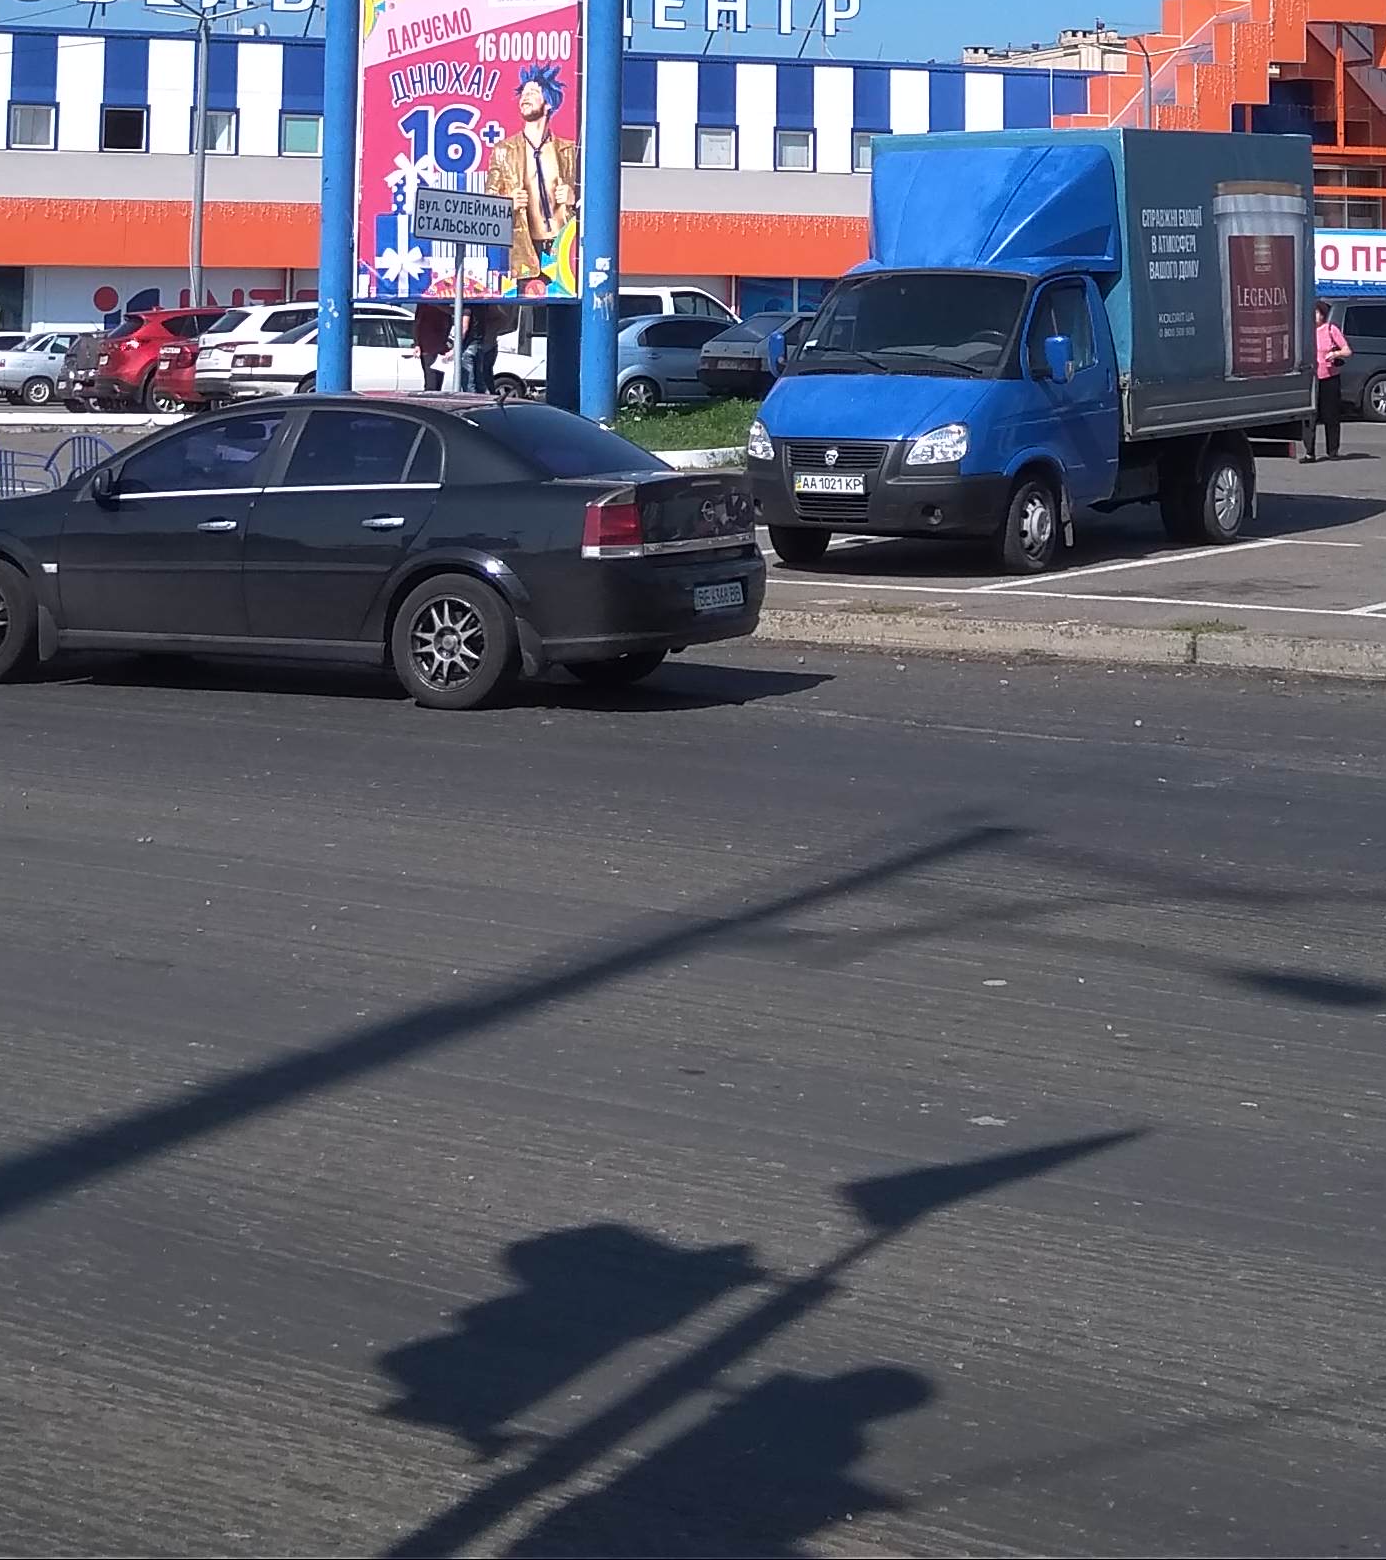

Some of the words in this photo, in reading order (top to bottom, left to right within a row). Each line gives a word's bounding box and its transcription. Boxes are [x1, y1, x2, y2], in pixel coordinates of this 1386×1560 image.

[387, 6, 473, 57] ДАРУЄМО
[475, 32, 497, 62] 16
[389, 60, 501, 107] ДНЮХА!
[418, 198, 442, 213] вул.
[445, 197, 513, 220] СУЛЕЙМАНА
[418, 216, 501, 239] СТАЛЬСЬКОГО
[1238, 285, 1288, 307] LEGENDA
[802, 477, 817, 489] AA
[819, 477, 843, 490] 1021
[845, 478, 862, 490] KP
